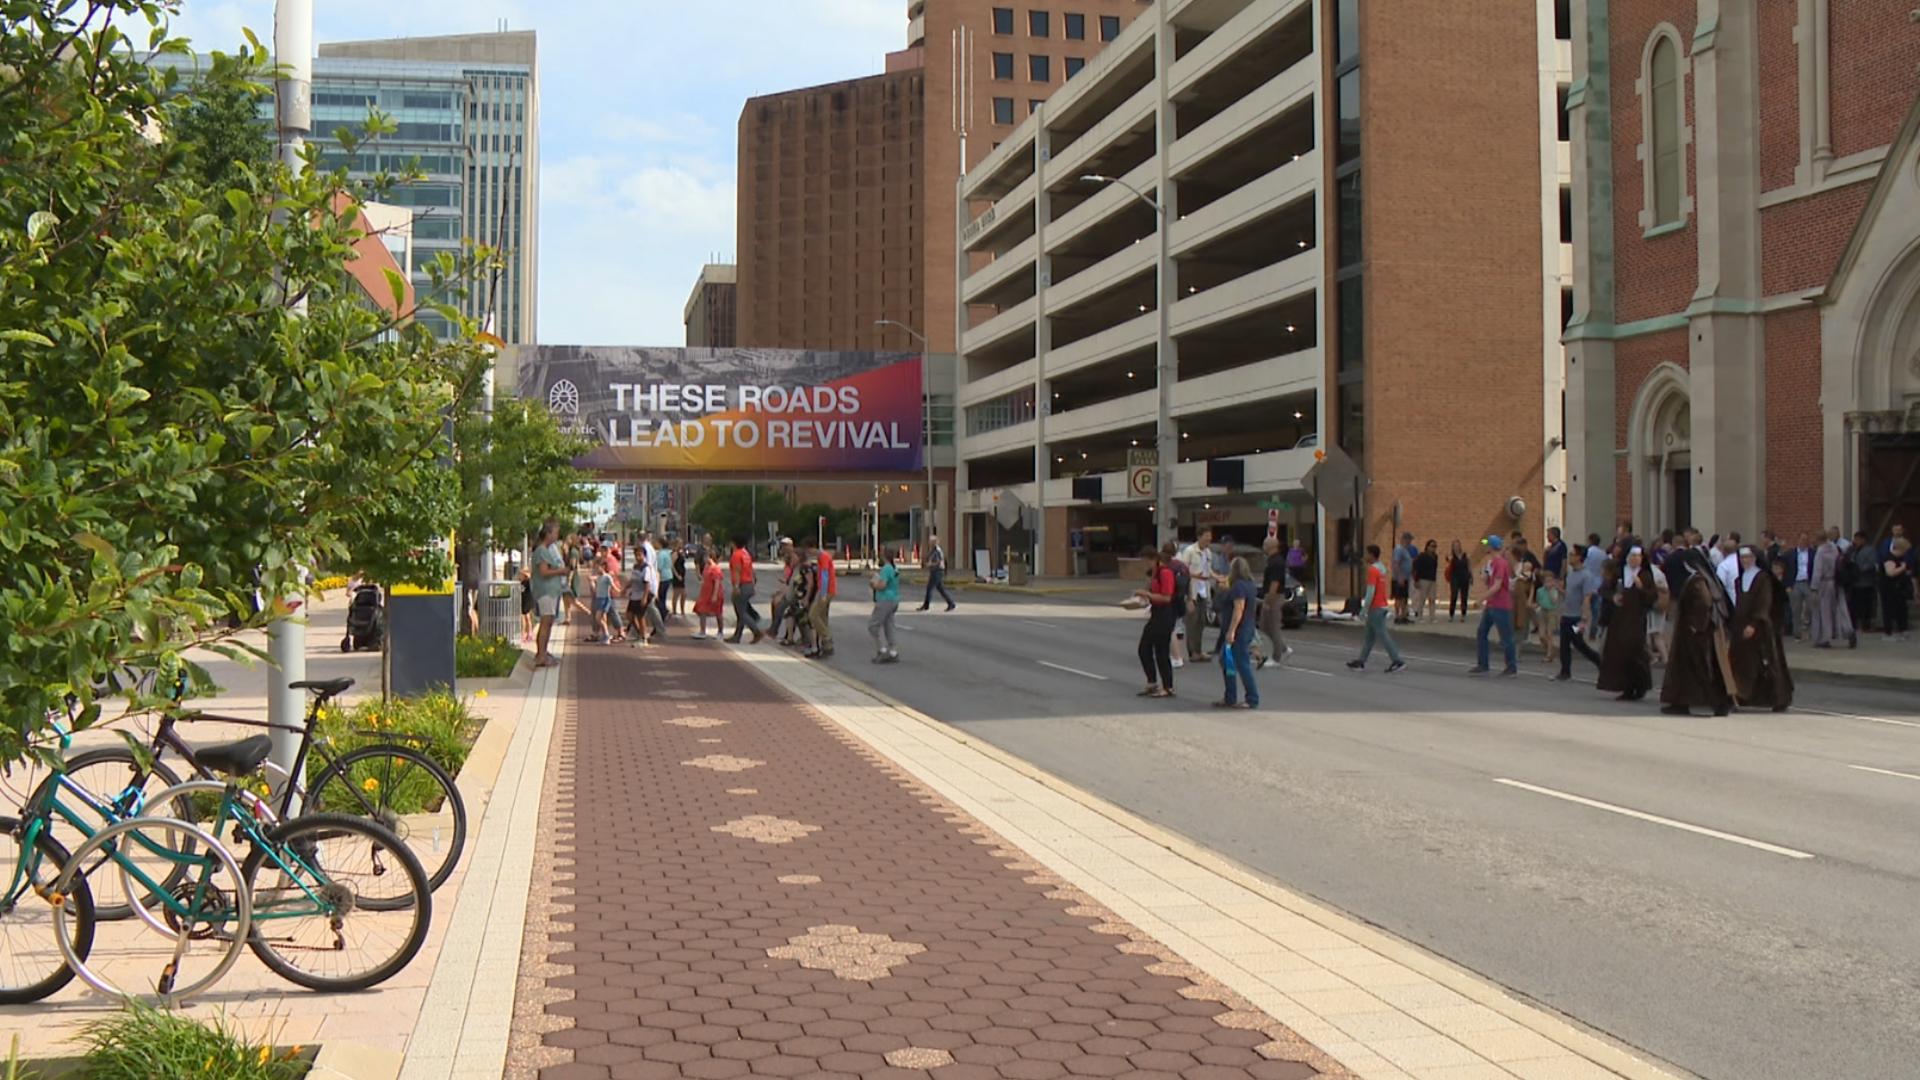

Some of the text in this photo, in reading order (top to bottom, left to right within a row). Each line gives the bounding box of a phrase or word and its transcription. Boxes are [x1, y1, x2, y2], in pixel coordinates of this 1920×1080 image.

[609, 383, 860, 414] THESE ROADS
[609, 418, 910, 449] LEAD TO REVIVAL
